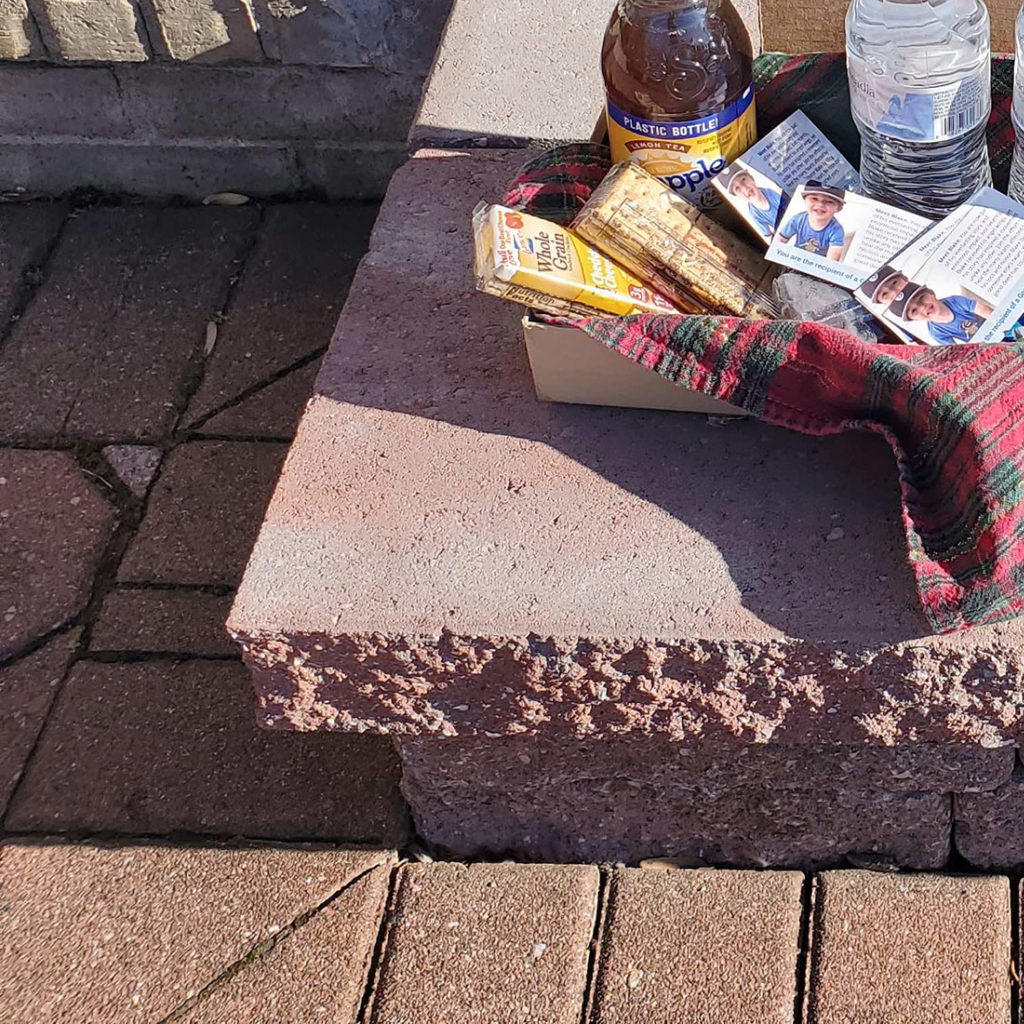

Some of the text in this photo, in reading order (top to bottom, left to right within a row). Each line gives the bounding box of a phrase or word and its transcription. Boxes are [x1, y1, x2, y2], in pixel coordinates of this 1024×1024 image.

[624, 116, 719, 136] PLASTIC BOTTLE!
[631, 142, 661, 150] LEMON
[657, 158, 726, 192] pple
[534, 231, 553, 272] Whole
[551, 233, 568, 271] Grain
[775, 248, 789, 258] You
[802, 257, 814, 266] the
[813, 262, 844, 278] recipient
[843, 272, 853, 280] of
[510, 285, 555, 304] Nutrition
[983, 330, 994, 341] the
[990, 307, 1013, 332] recipient
[1008, 300, 1016, 308] of
